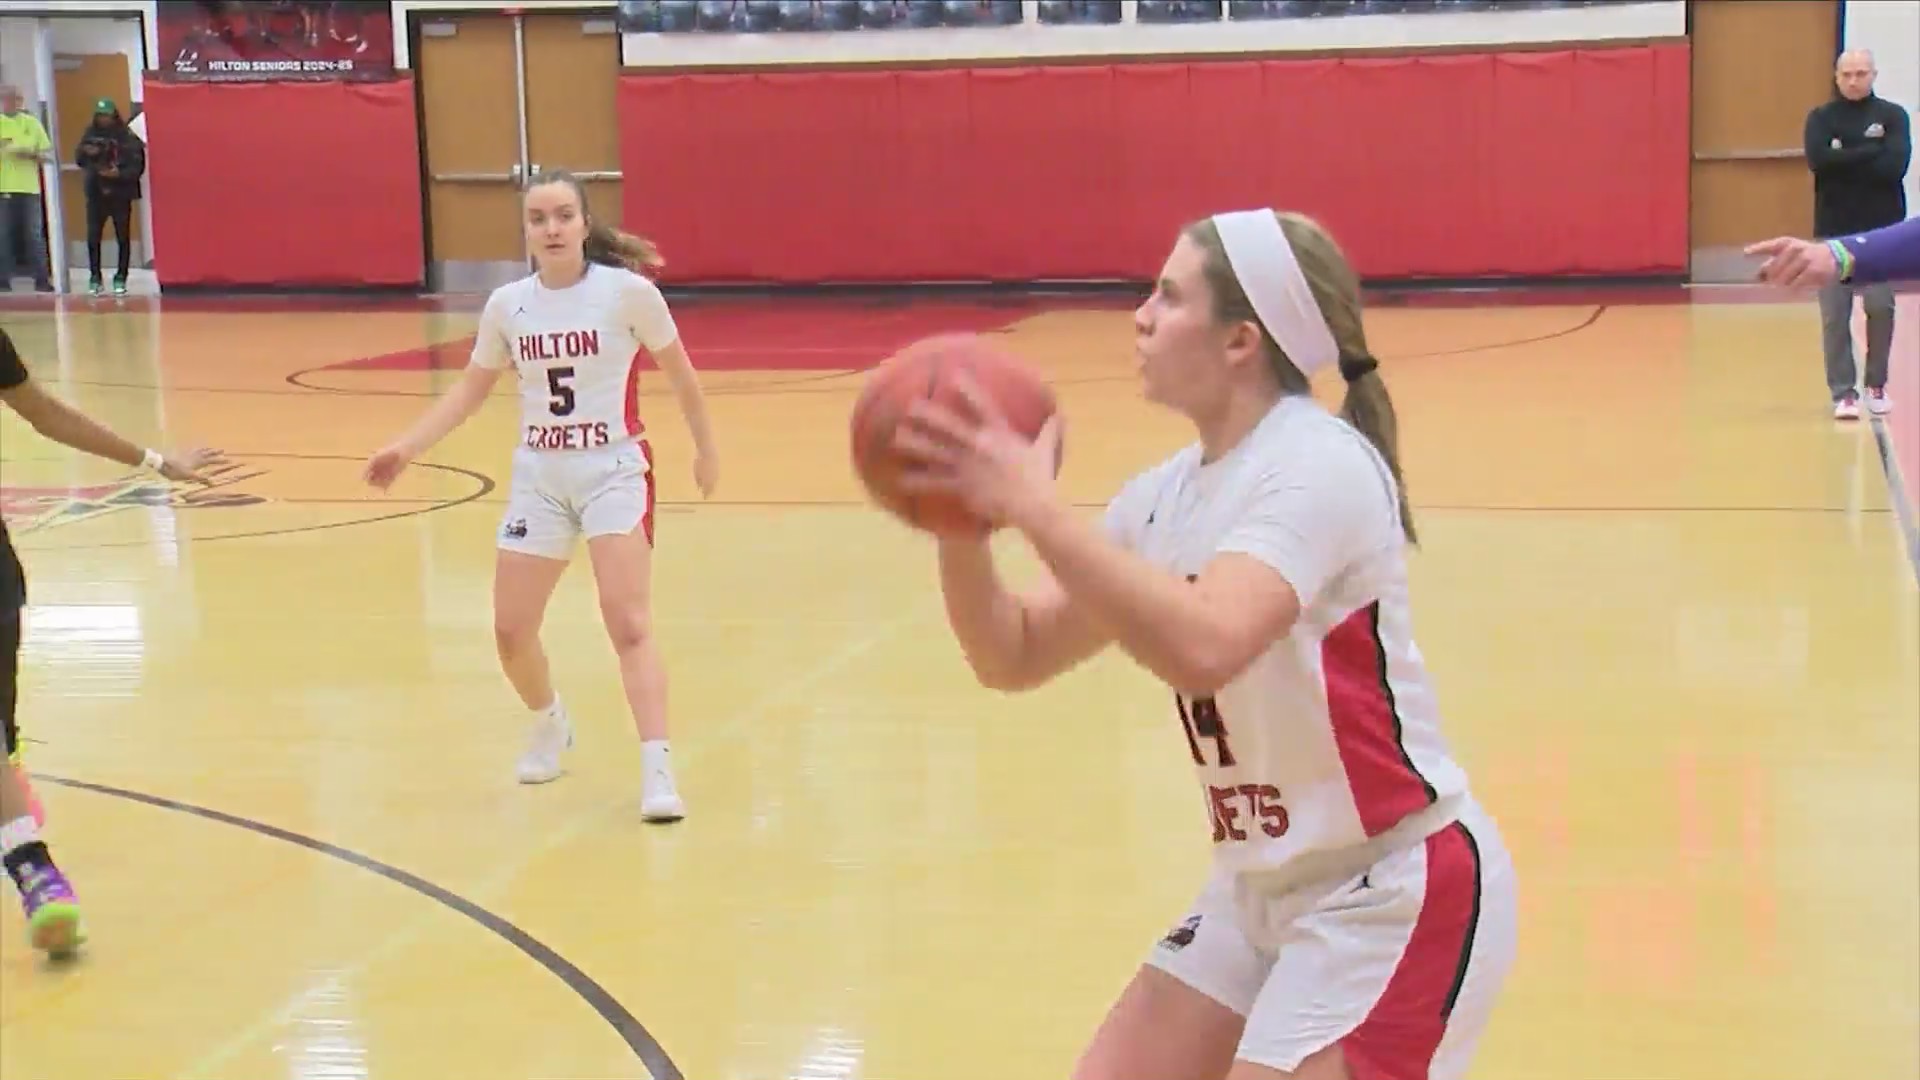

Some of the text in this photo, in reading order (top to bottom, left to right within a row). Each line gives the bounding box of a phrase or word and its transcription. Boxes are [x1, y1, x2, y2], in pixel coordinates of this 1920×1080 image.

[208, 61, 251, 71] HILTON
[252, 61, 301, 71] SENIORS
[519, 329, 599, 361] HILTON
[547, 366, 575, 417] 5
[527, 421, 609, 449] CADETS
